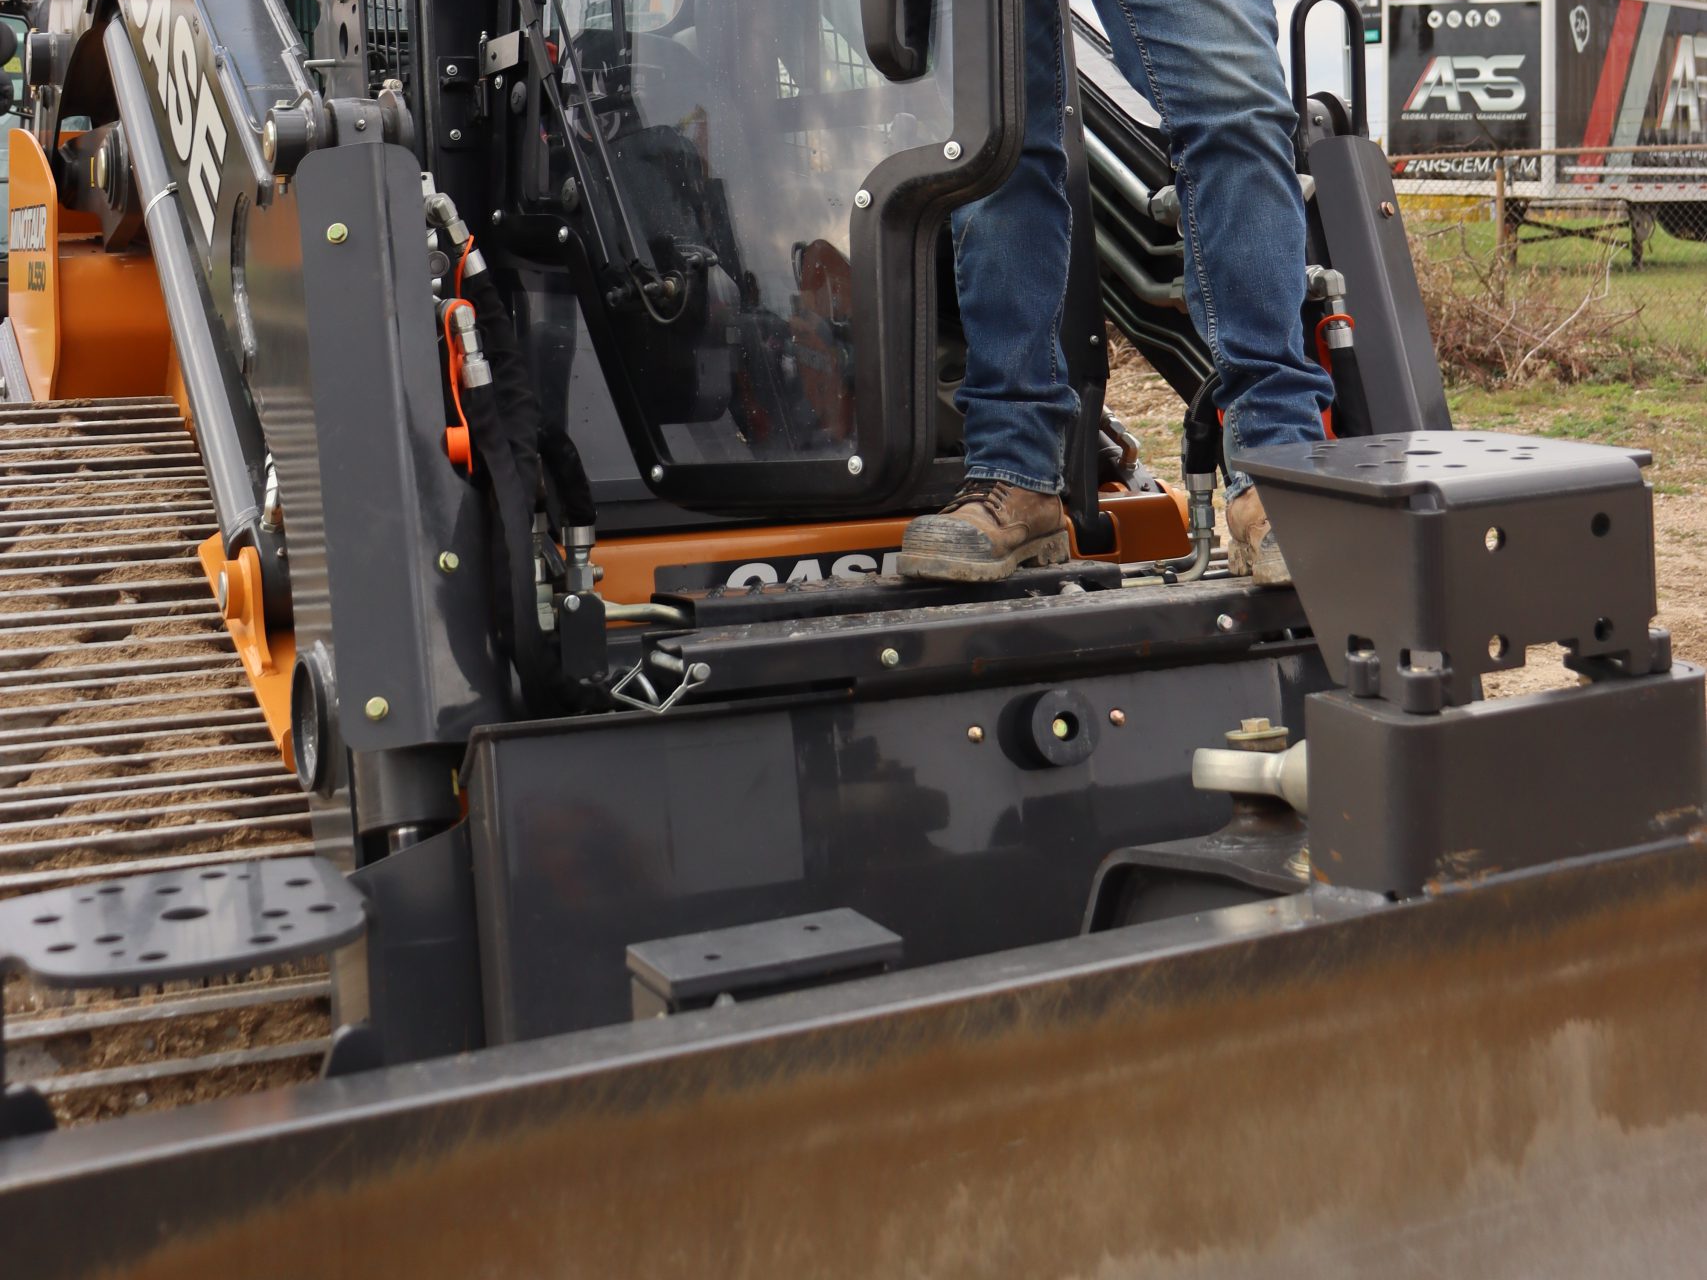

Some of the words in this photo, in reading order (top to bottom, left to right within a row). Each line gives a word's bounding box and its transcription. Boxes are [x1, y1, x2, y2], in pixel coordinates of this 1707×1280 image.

[1403, 55, 1526, 111] ARS
[1401, 113, 1429, 121] GLOBAL
[1430, 113, 1473, 121] EMERGENCY
[10, 204, 47, 252] MINOTAUR
